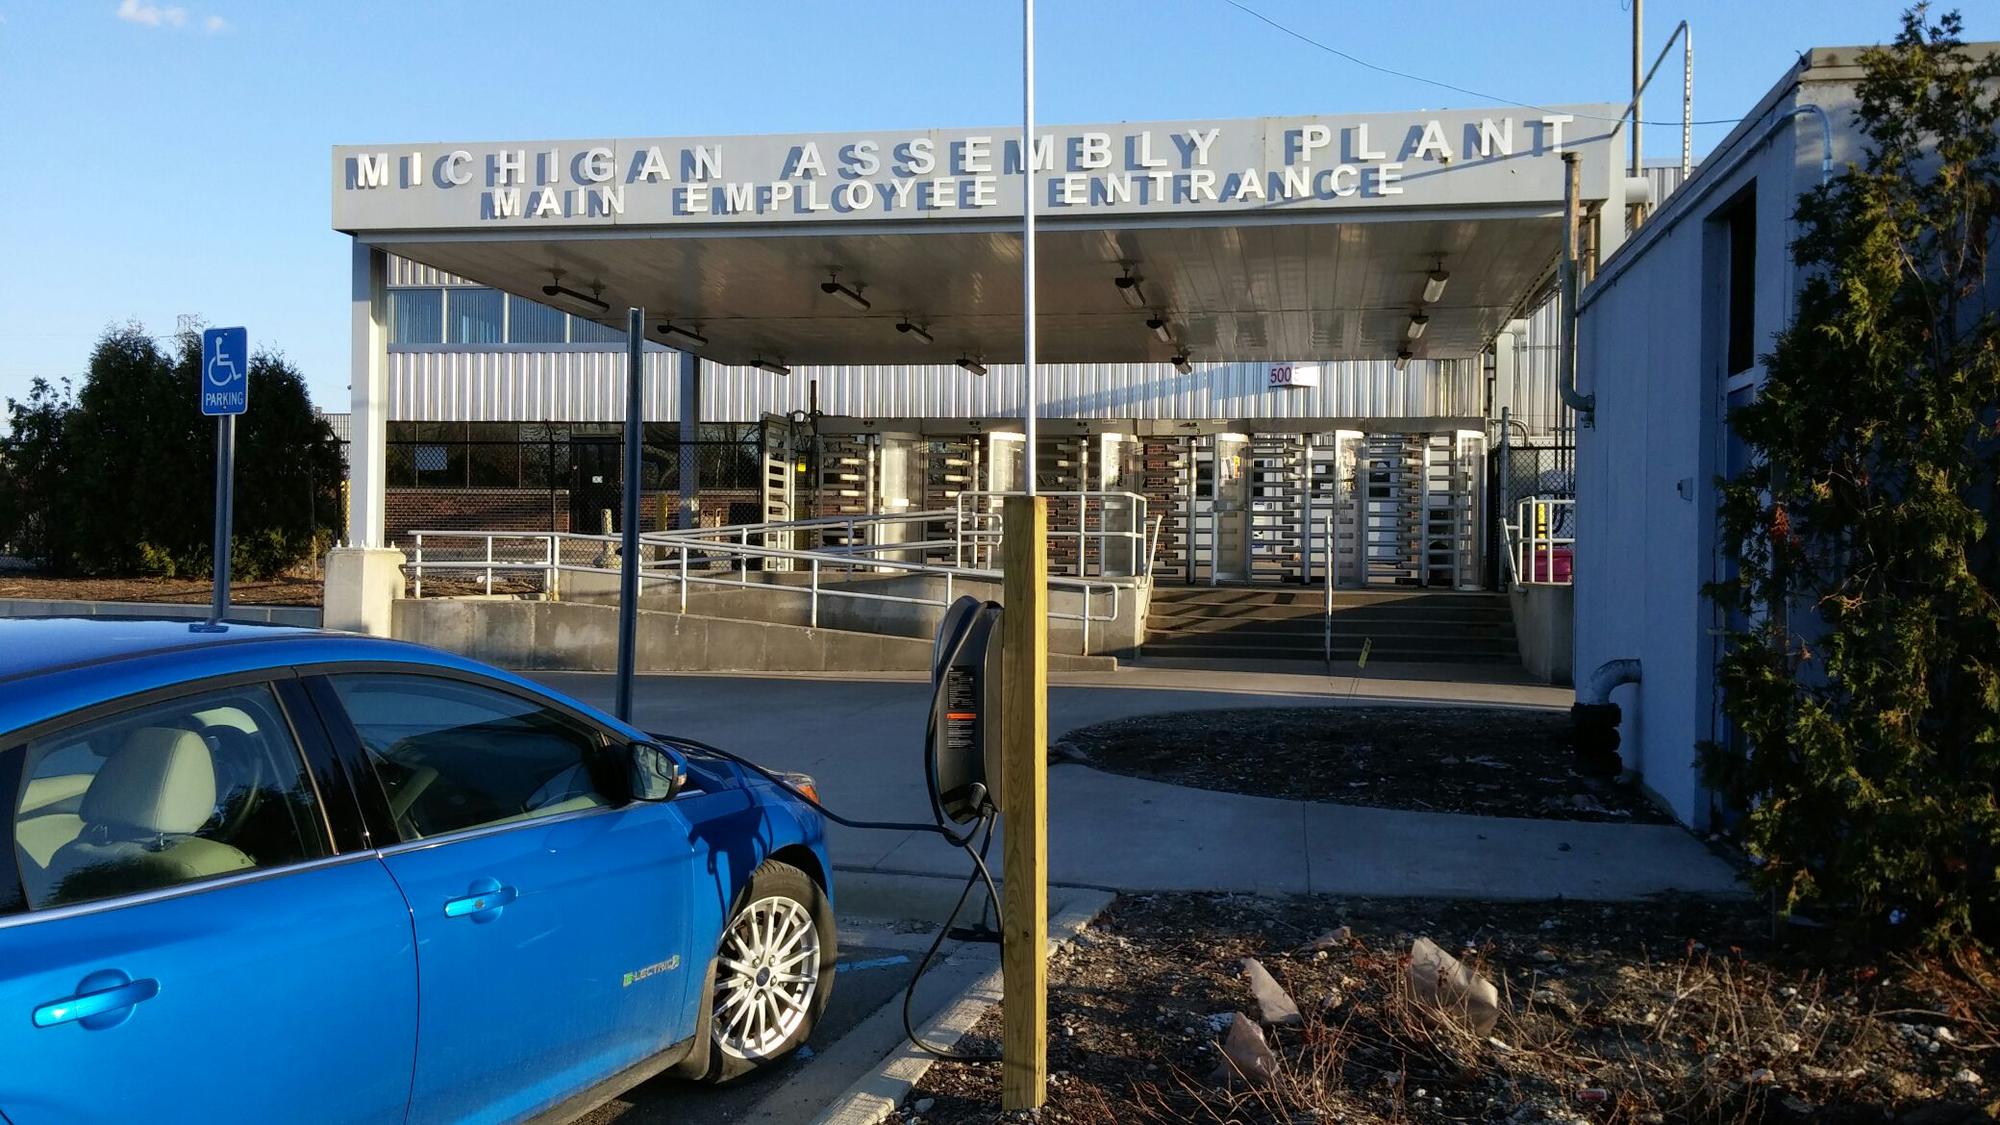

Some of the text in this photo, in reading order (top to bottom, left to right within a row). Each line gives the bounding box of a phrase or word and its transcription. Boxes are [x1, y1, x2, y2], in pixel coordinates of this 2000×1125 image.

[357, 115, 1574, 188] MICHIGAN ASSEMBLY PLANT
[494, 164, 1404, 217] MAIN EMPLOYEE ENTRANCE
[1270, 367, 1292, 383] 500
[205, 391, 244, 407] PARKING
